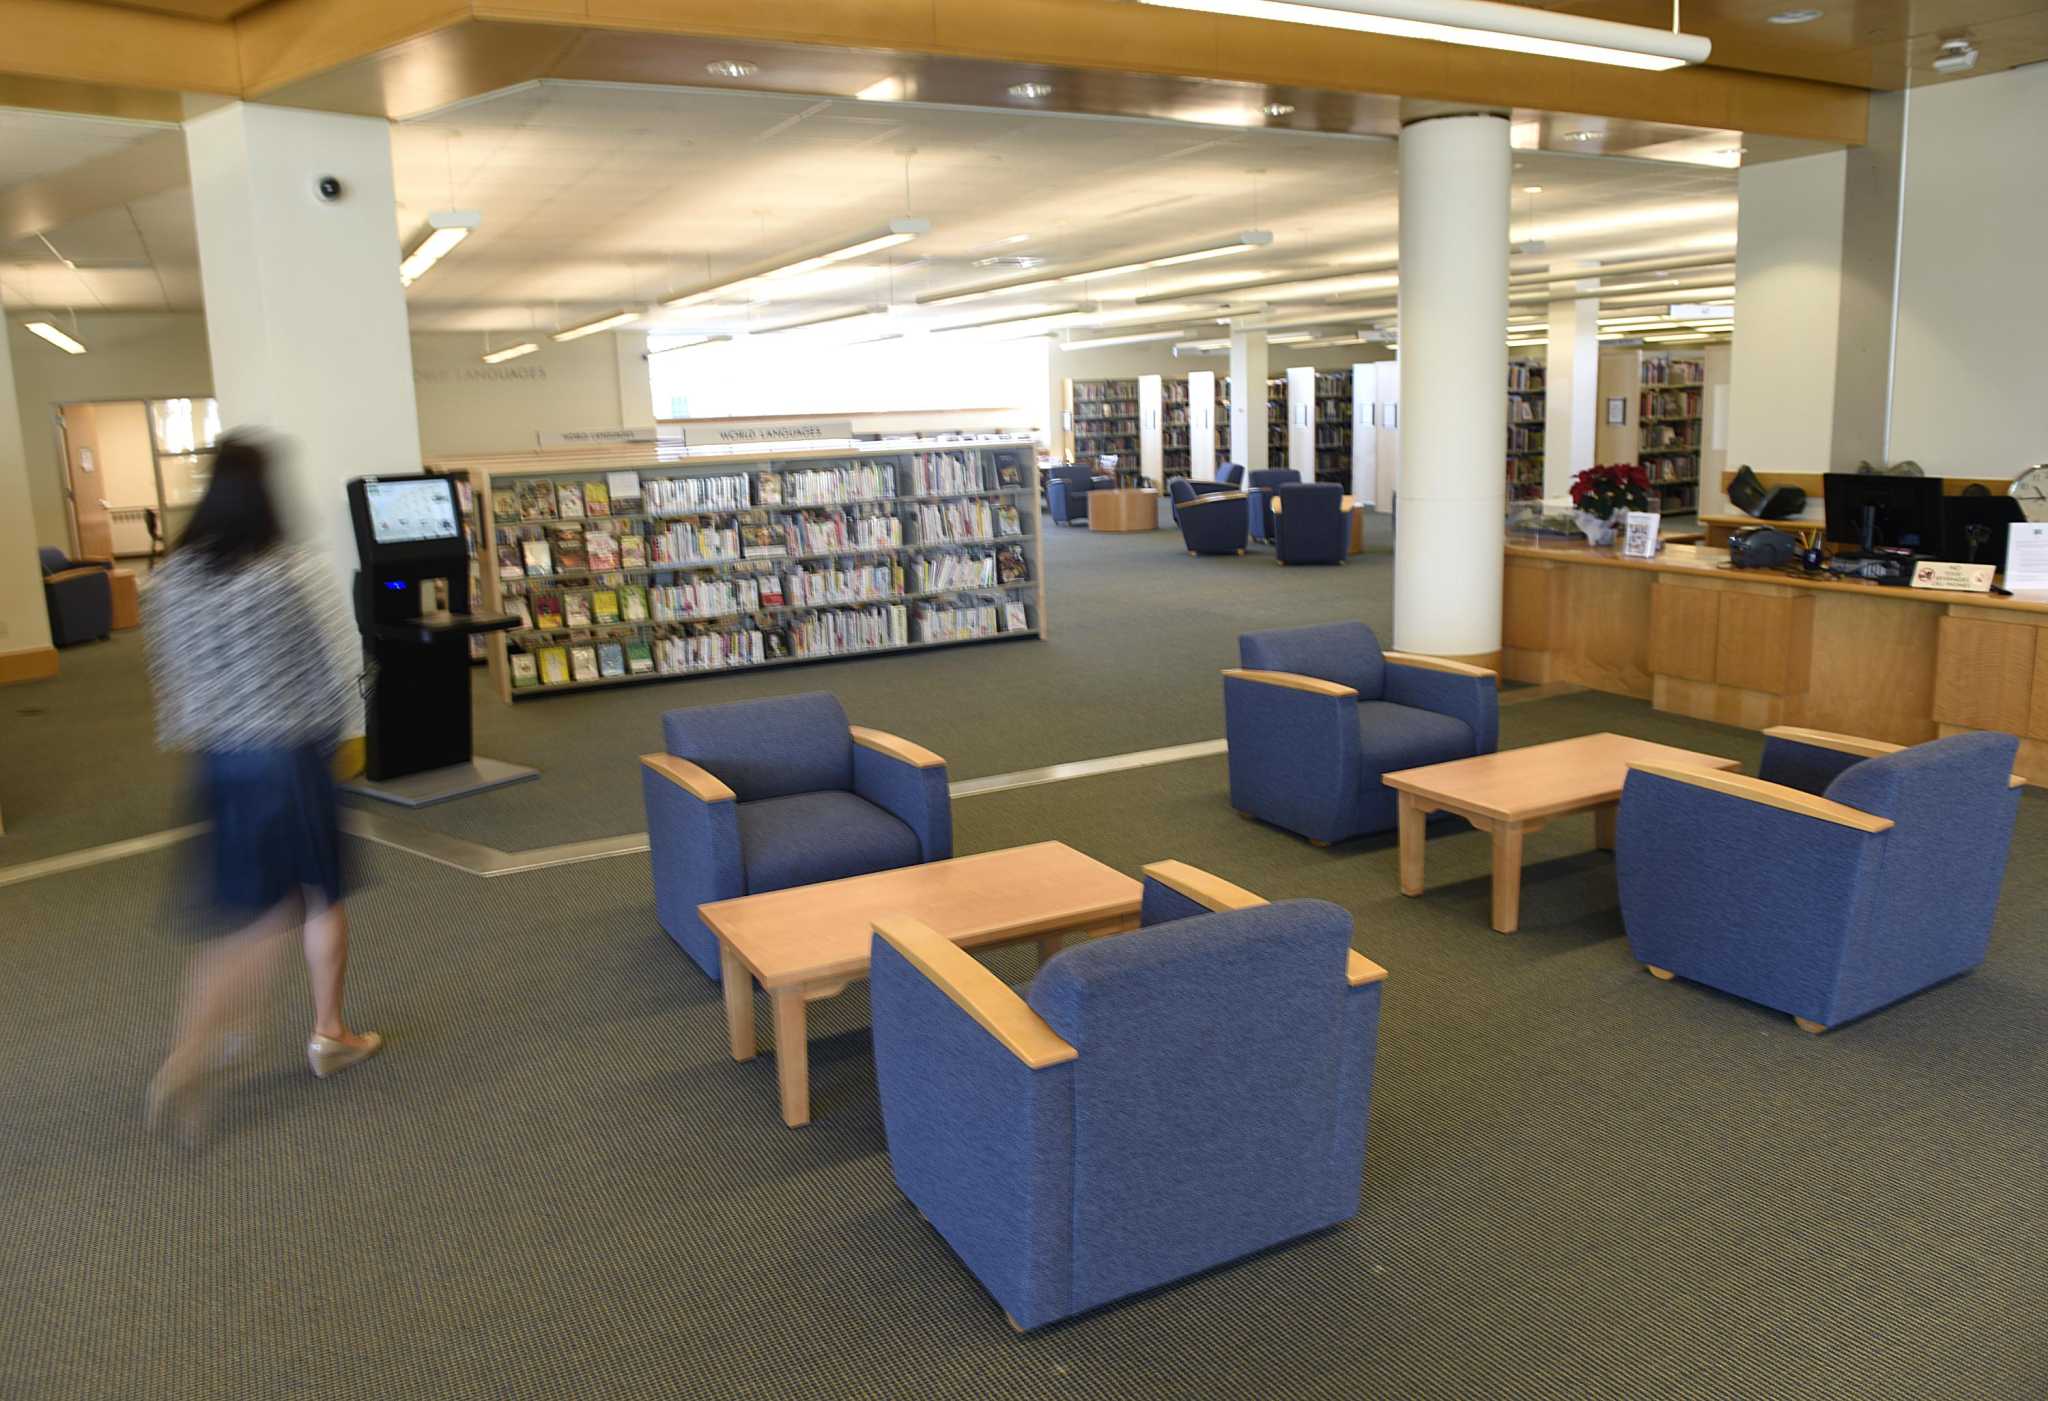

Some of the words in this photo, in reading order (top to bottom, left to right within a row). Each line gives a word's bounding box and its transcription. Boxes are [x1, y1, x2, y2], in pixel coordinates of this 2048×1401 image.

[456, 366, 546, 382] LANGUAGES
[720, 429, 756, 441] WORLD
[760, 424, 822, 440] LANGUAGES
